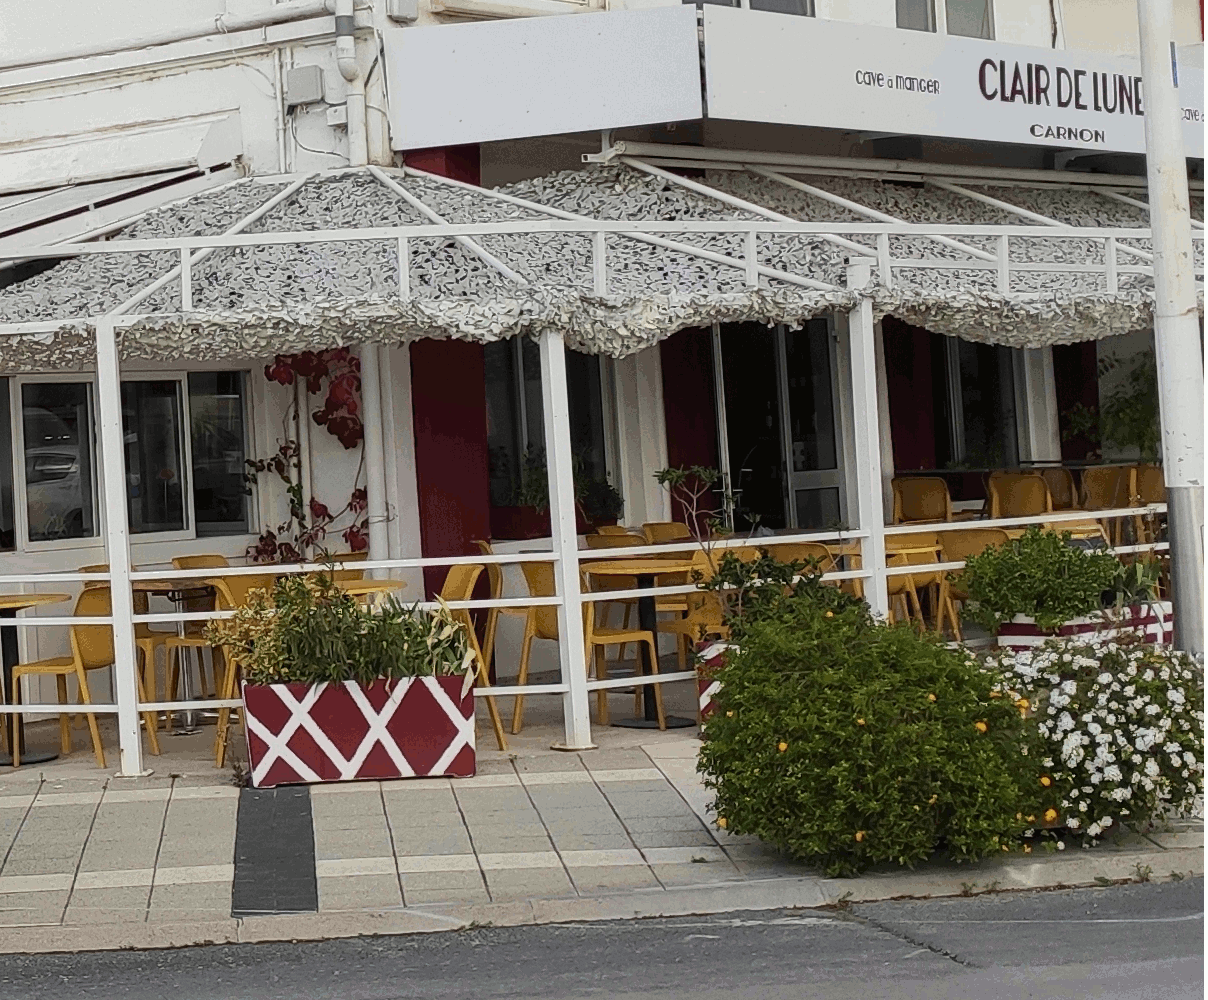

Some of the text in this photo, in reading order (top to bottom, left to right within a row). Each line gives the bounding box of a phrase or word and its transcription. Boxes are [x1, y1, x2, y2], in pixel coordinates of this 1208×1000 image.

[978, 58, 1145, 117] CLAIR DE LUNE
[1028, 123, 1106, 143] CARNON
